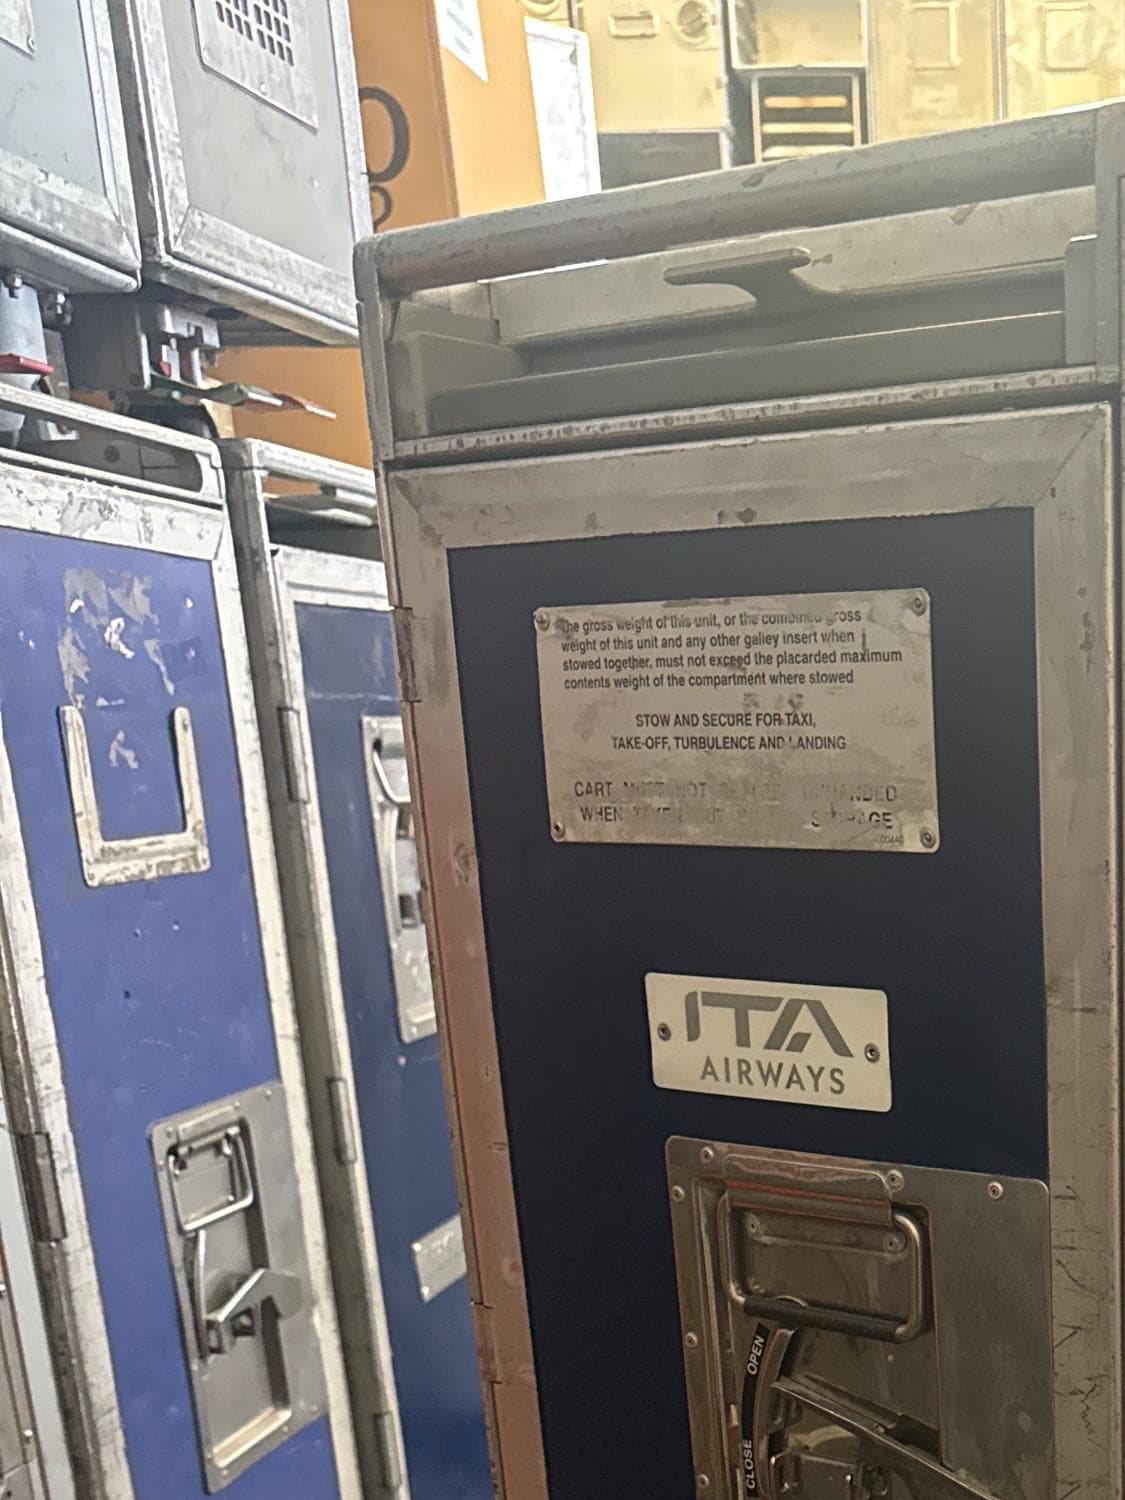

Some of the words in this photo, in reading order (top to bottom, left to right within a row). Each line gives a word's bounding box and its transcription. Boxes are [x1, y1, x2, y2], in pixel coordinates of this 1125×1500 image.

[560, 618, 580, 634] he
[582, 620, 614, 636] gross
[616, 616, 653, 634] weight
[656, 615, 668, 629] of
[669, 614, 691, 628] this
[694, 613, 721, 629] unit,
[724, 615, 737, 626] or
[739, 612, 758, 626] the
[561, 638, 596, 655] weight
[599, 636, 610, 651] of
[613, 636, 634, 650] this
[637, 635, 658, 649] unit
[661, 634, 682, 648] and
[685, 635, 706, 650] any
[710, 633, 740, 648] other
[744, 632, 779, 649] galley
[782, 631, 817, 645] insert
[820, 629, 855, 644] when
[563, 657, 601, 671] stowed
[655, 655, 684, 668] must
[687, 654, 706, 668] not
[709, 652, 751, 668] exceed
[754, 651, 773, 665] the
[777, 650, 837, 668] placarded
[840, 648, 903, 663] maximum
[564, 676, 611, 690] contents
[613, 675, 650, 691] weight
[653, 674, 664, 688] of
[667, 674, 685, 687] the
[688, 672, 766, 690] compartment
[769, 671, 806, 685] where
[809, 670, 854, 684] stowed
[636, 714, 670, 728] STOW
[673, 714, 699, 728] AND
[702, 713, 753, 727] SECURE
[756, 713, 782, 727] FOR
[785, 712, 816, 729] TAXI,
[612, 736, 671, 752] TAKE-OFF,
[674, 736, 755, 750] TURBULENCE
[758, 736, 785, 750] AND
[574, 780, 613, 797] CART
[685, 991, 855, 1058] ITA
[700, 1055, 846, 1095] AIRWAYS
[747, 1335, 765, 1376] OPEN
[744, 1439, 756, 1490] CLOSE
